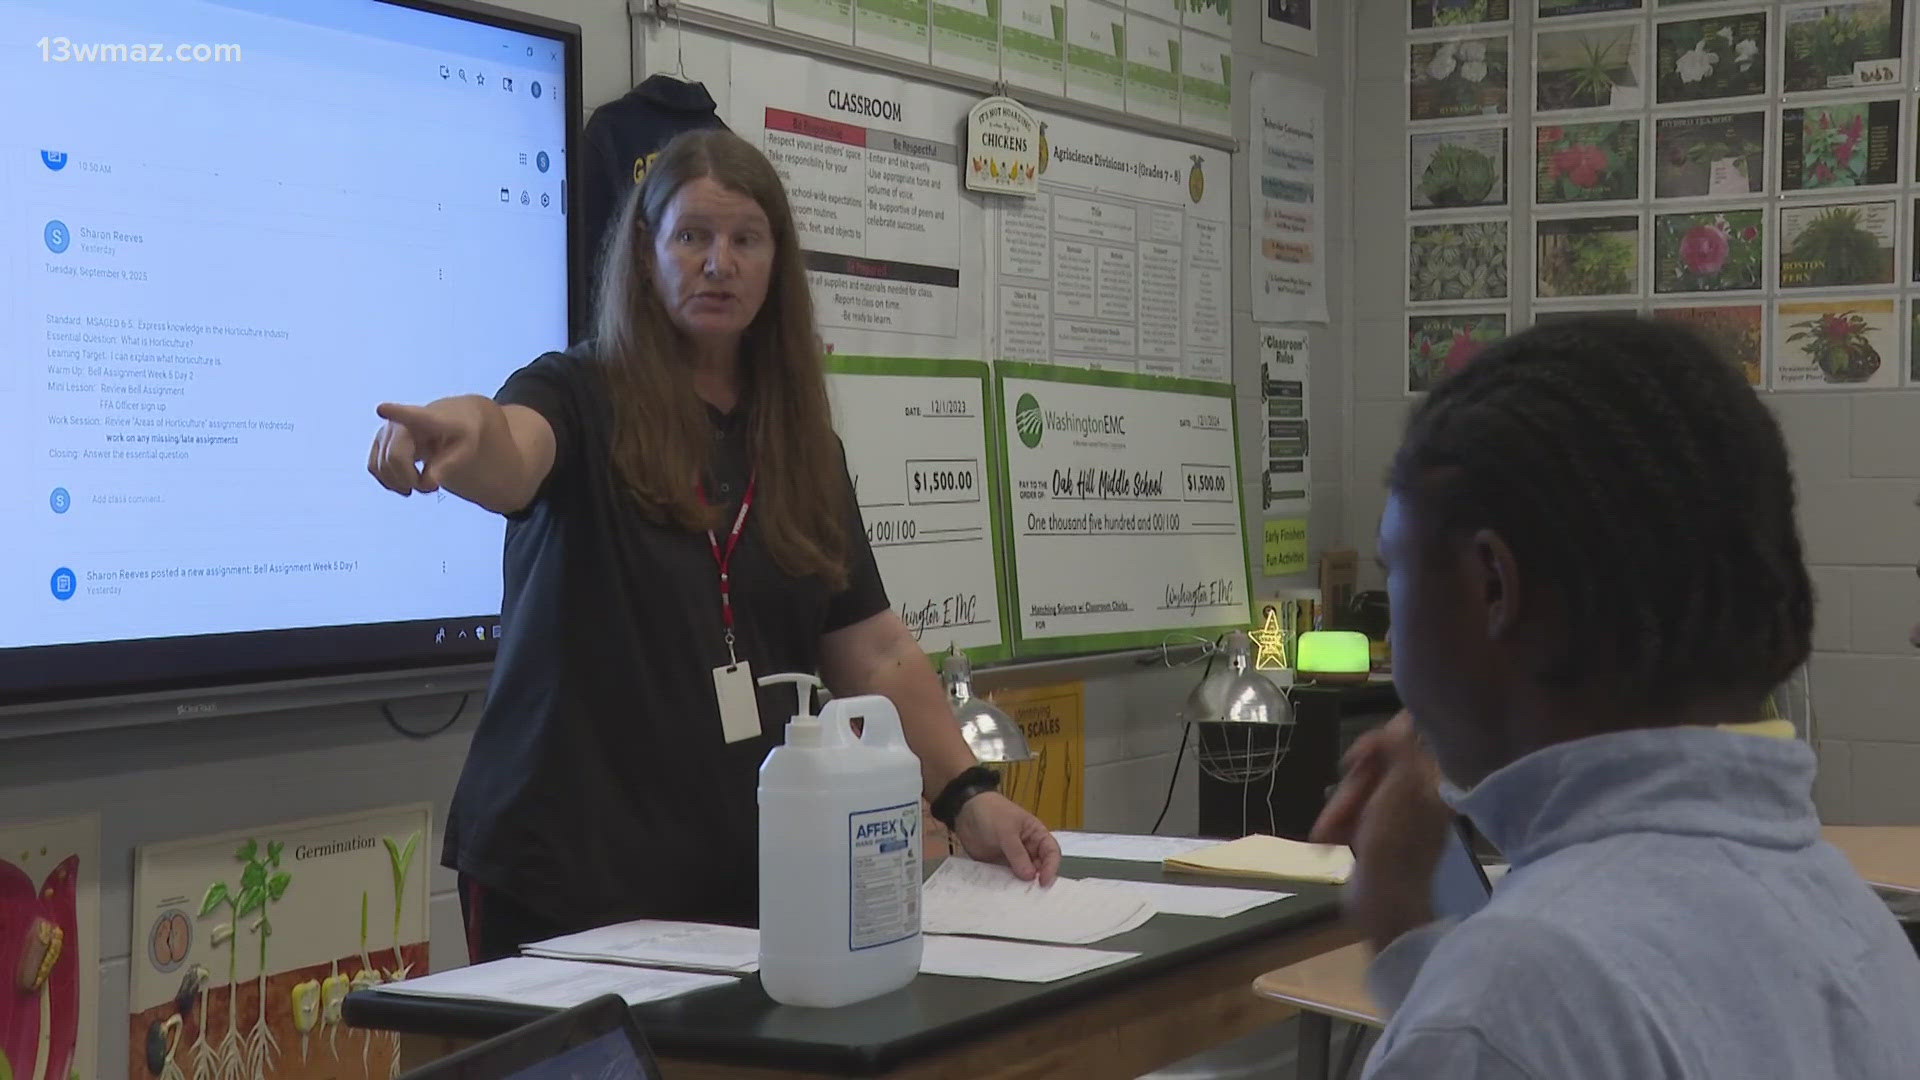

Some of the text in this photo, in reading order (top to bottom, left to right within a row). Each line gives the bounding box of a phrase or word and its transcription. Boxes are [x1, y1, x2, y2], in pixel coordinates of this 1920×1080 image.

[829, 89, 902, 122] CLASSROOM
[990, 107, 1001, 118] NOT
[813, 141, 824, 151] and
[902, 141, 937, 157] Respectful
[982, 132, 1027, 152] CHICKENS
[887, 155, 898, 166] and
[1053, 146, 1093, 165] Agriscience
[1094, 154, 1124, 173] Divisions
[834, 163, 848, 173] your
[867, 216, 896, 229] celebrate
[80, 228, 144, 243] Sharon Reeves
[81, 244, 116, 257] Yesterday
[80, 266, 120, 279] September
[130, 271, 149, 281] 2025
[1782, 260, 1826, 271] BOSTON
[823, 277, 848, 290] supplies
[849, 280, 859, 290] and
[859, 281, 886, 294] materials
[887, 283, 908, 296] needed
[875, 299, 883, 309] on
[138, 320, 166, 333] Express
[166, 321, 203, 335] knowledge
[212, 325, 224, 336] the
[224, 326, 263, 338] Horticulture
[47, 331, 81, 343] Essential
[120, 334, 139, 346] What
[149, 337, 194, 349] Horticulture?
[1266, 335, 1303, 351] Classroom
[47, 347, 213, 367] Learning can explain what horticulture
[1276, 350, 1294, 364] Rules
[48, 364, 189, 382] Warm Bell Assignment Week Day
[48, 382, 65, 393] Mini
[100, 383, 127, 395] Review
[128, 384, 142, 395] Bell
[143, 385, 185, 398] Assignment
[100, 399, 167, 413] FFA Officer sign up
[931, 400, 967, 414] 12/1/2023
[48, 415, 68, 426] Work
[105, 416, 131, 427] Review
[208, 419, 248, 431] assignment
[259, 420, 295, 433] Wednesday
[1045, 411, 1126, 438] WashingtonEMC
[106, 433, 239, 446] work on any missing/late assignments
[83, 449, 111, 460] Answer
[112, 449, 125, 460] the
[126, 449, 158, 460] essential
[159, 450, 189, 462] question
[913, 470, 972, 494] $1,500.00
[1052, 467, 1225, 500] Oak Hill Middle School $1,500.00
[92, 495, 127, 504] Add class
[876, 520, 916, 542] 00/100
[1027, 512, 1180, 534] One thousand five hundred and 00/100
[1265, 527, 1305, 545] Early Finishers
[1266, 551, 1305, 566] Fun Activities
[87, 570, 118, 581] Sharon
[119, 569, 149, 580] Reeves
[151, 567, 179, 580] posted
[187, 568, 204, 577] new
[254, 563, 268, 574] Bell
[269, 562, 312, 575] Assignment
[313, 560, 332, 571] Week
[340, 560, 354, 572] Day
[87, 586, 122, 596] Yesterday
[1027, 717, 1061, 739] SCALES
[856, 819, 897, 840] AFFEX
[295, 834, 376, 861] Germination
